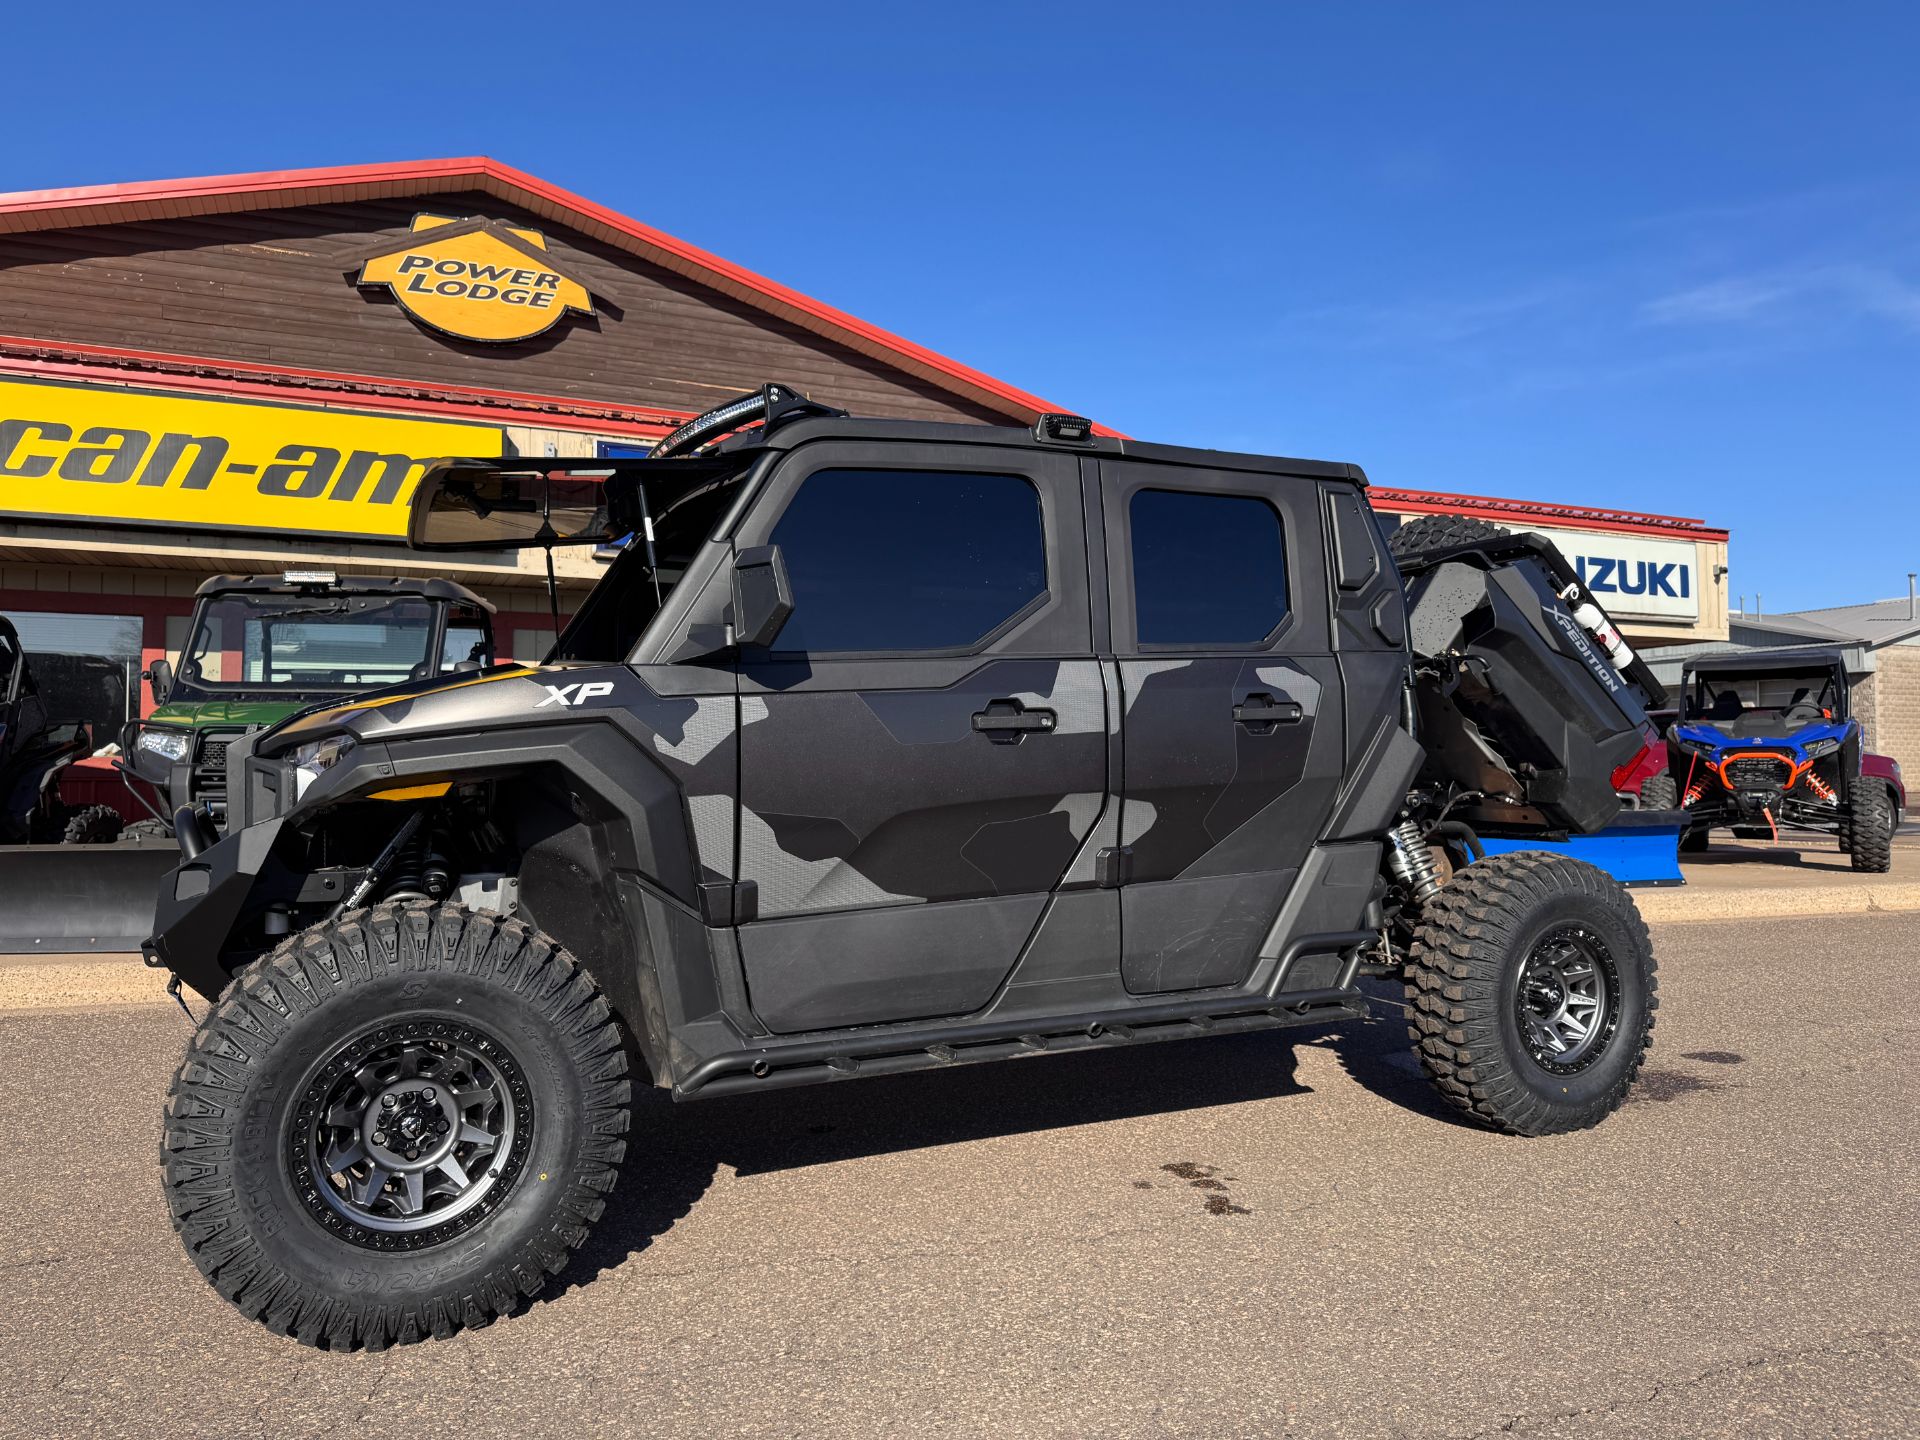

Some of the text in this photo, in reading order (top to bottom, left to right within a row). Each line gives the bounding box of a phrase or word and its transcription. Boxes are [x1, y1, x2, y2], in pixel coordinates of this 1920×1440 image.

[398, 256, 561, 290] POWER
[407, 274, 555, 308] LODGE
[0, 419, 438, 506] can-am
[1541, 604, 1620, 693] XPEDITION
[533, 682, 615, 708] XP
